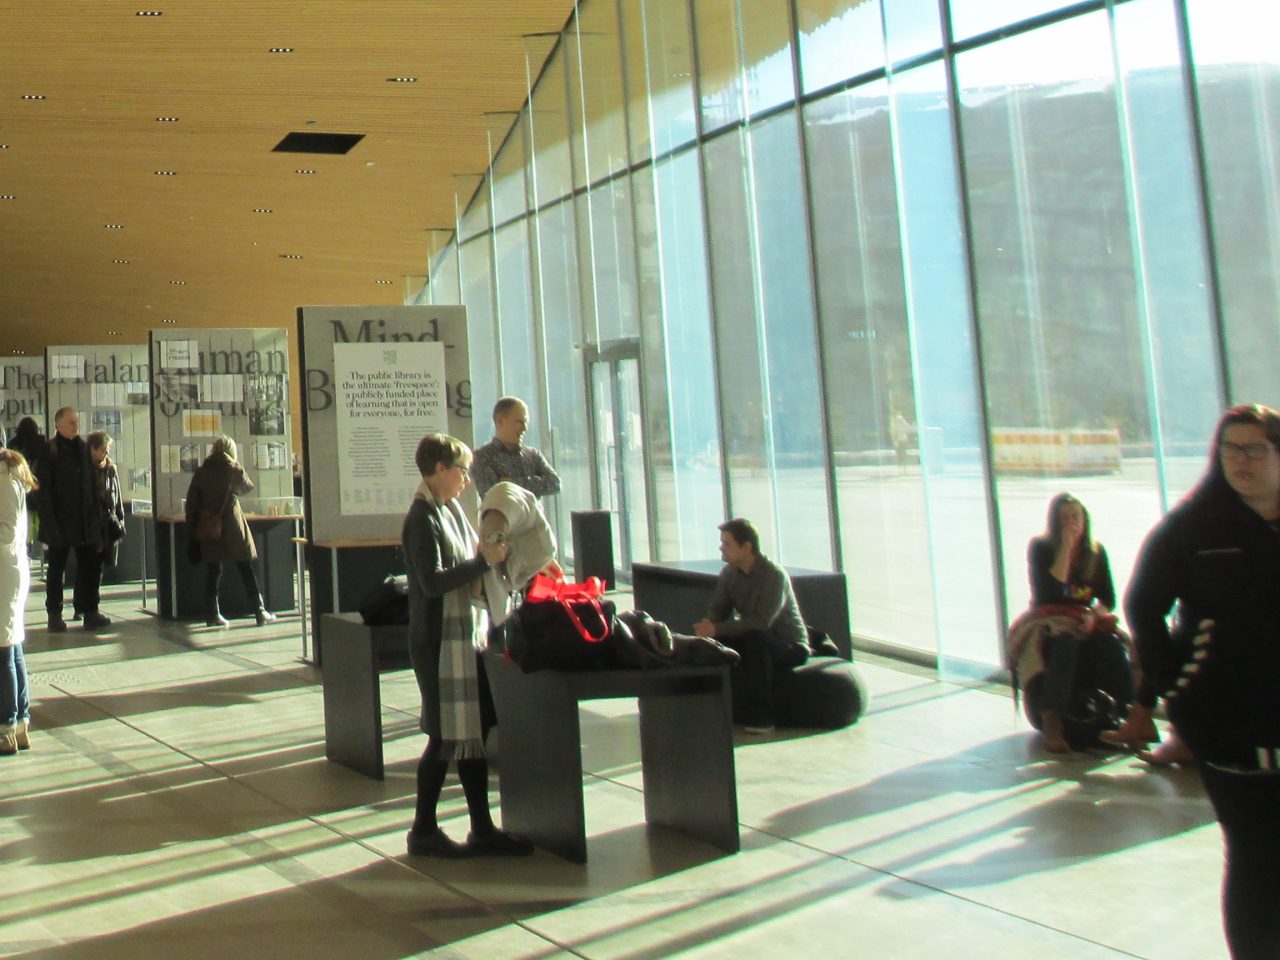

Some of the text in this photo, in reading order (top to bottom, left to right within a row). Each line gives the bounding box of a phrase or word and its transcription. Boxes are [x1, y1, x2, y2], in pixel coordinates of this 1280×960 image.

[153, 340, 289, 376] uman
[350, 371, 431, 382] The public library is
[342, 381, 356, 390] the
[357, 381, 391, 390] ultimate
[352, 390, 384, 401] publicly
[385, 390, 415, 399] funded
[416, 390, 439, 400] place
[346, 400, 439, 411] of learning that is open
[350, 408, 436, 420] for everyone, for free.
